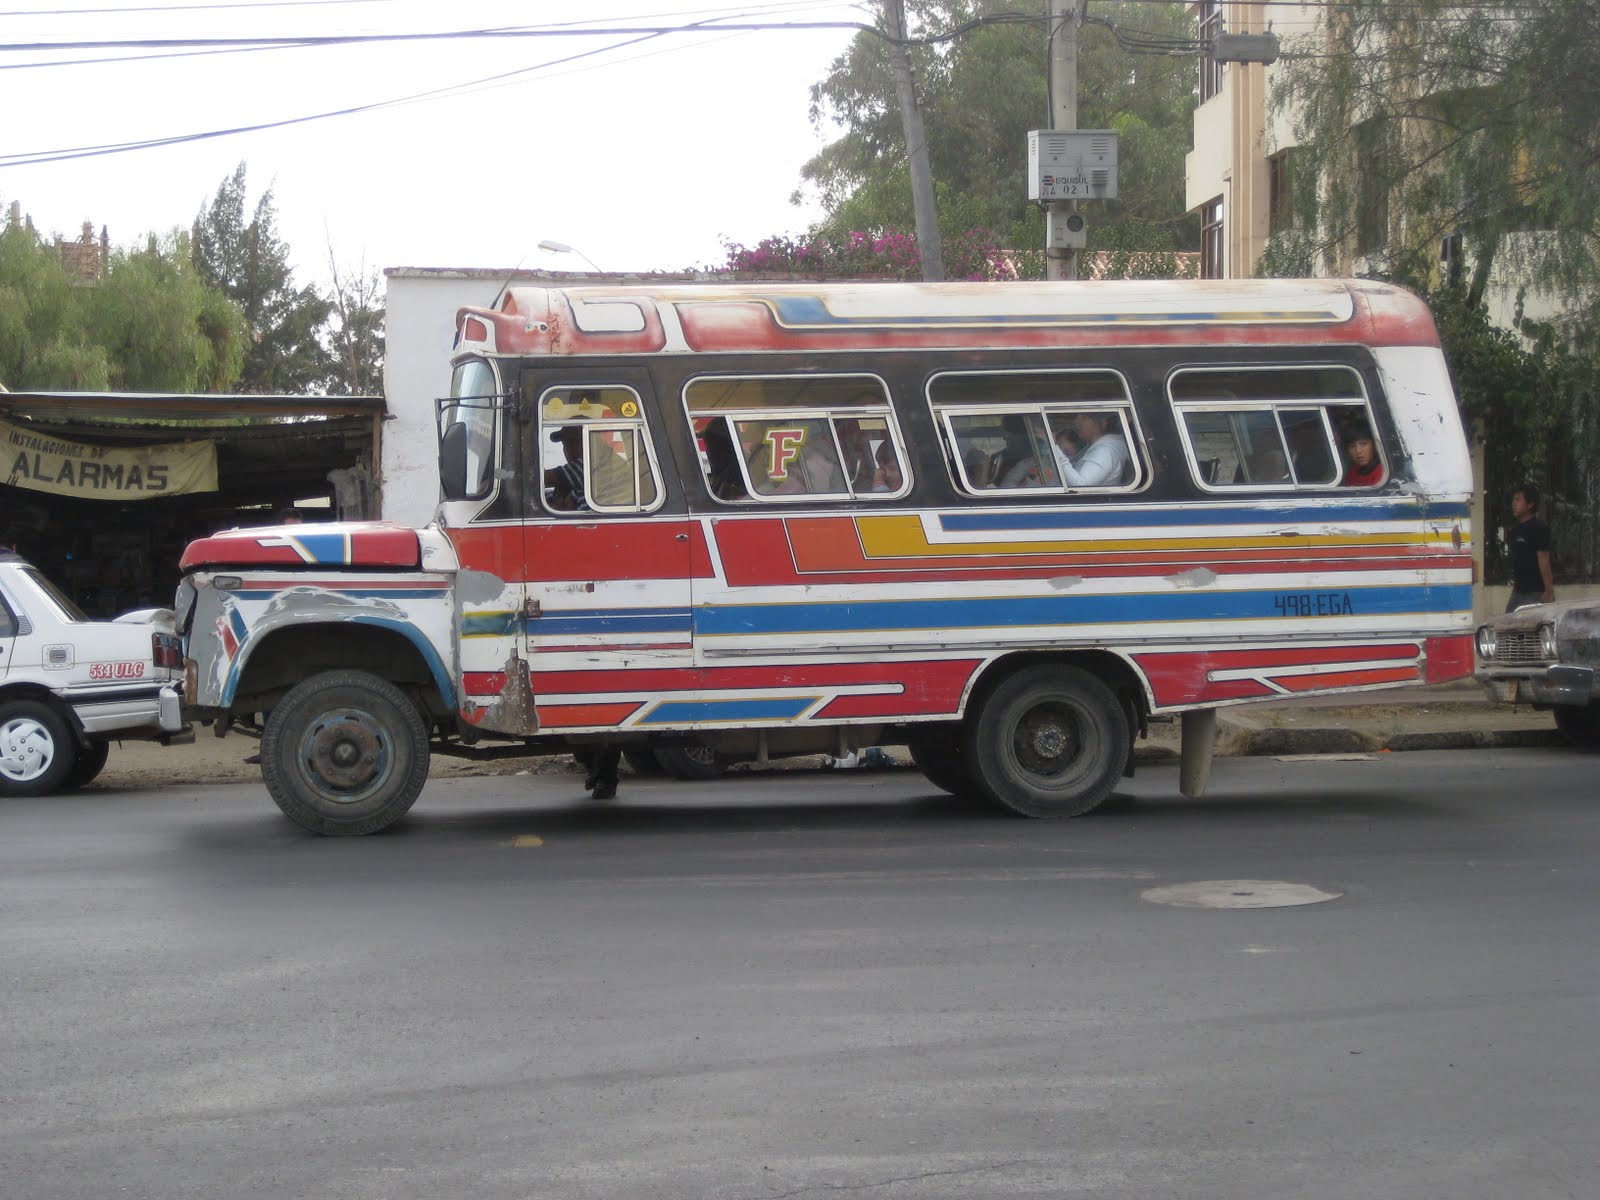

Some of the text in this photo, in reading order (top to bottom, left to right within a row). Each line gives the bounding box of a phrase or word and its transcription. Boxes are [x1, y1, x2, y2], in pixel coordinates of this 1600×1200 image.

[9, 431, 84, 457] INSTALACIONES
[763, 427, 806, 481] F
[11, 451, 169, 490] ALARMAS
[89, 661, 145, 679] 534 ULC
